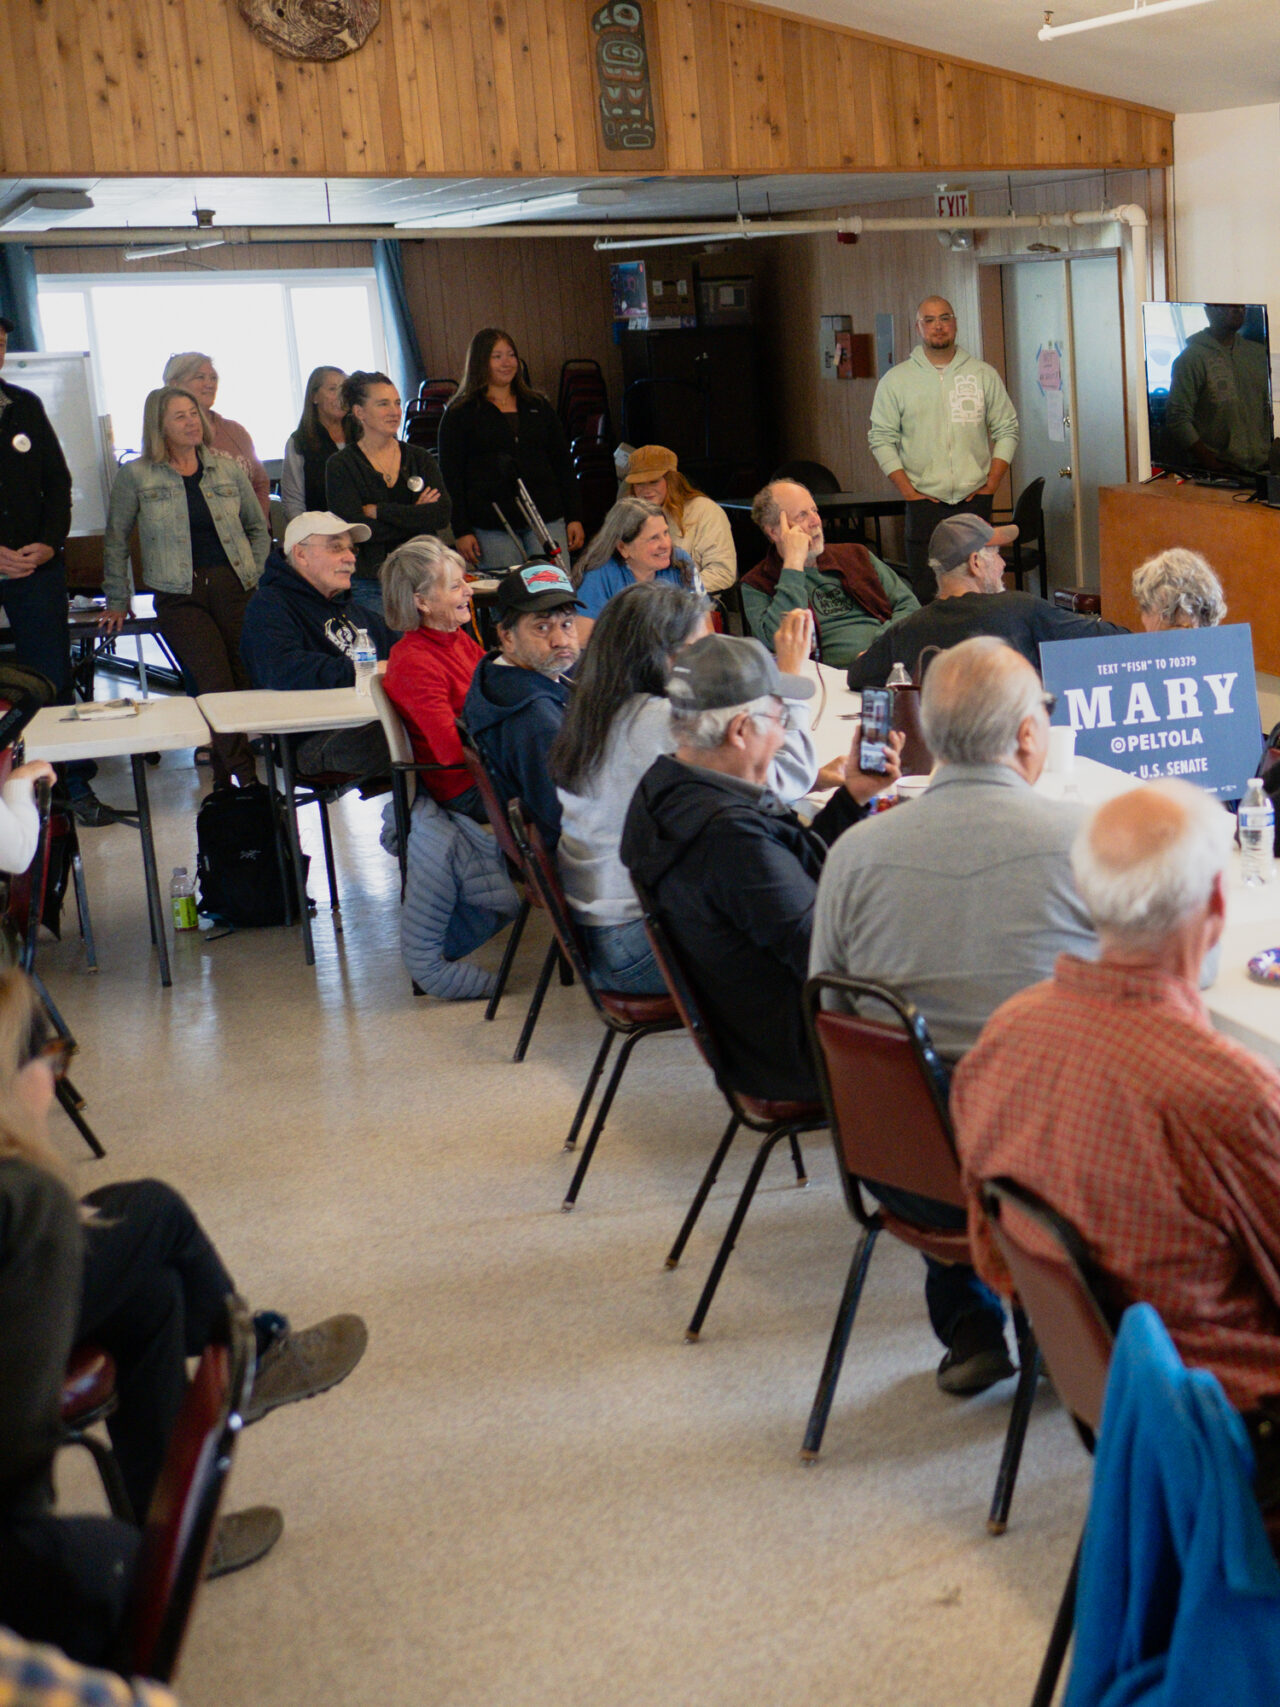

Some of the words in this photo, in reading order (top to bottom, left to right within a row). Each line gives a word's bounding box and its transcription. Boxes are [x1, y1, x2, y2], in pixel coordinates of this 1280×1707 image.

[938, 194, 967, 217] EXIT
[1097, 664, 1118, 675] TEXT
[1155, 659, 1166, 669] TO
[1169, 656, 1196, 668] 70379
[1064, 672, 1238, 730] MARY
[1140, 763, 1164, 778] U.S.
[1166, 758, 1208, 775] SENATE
